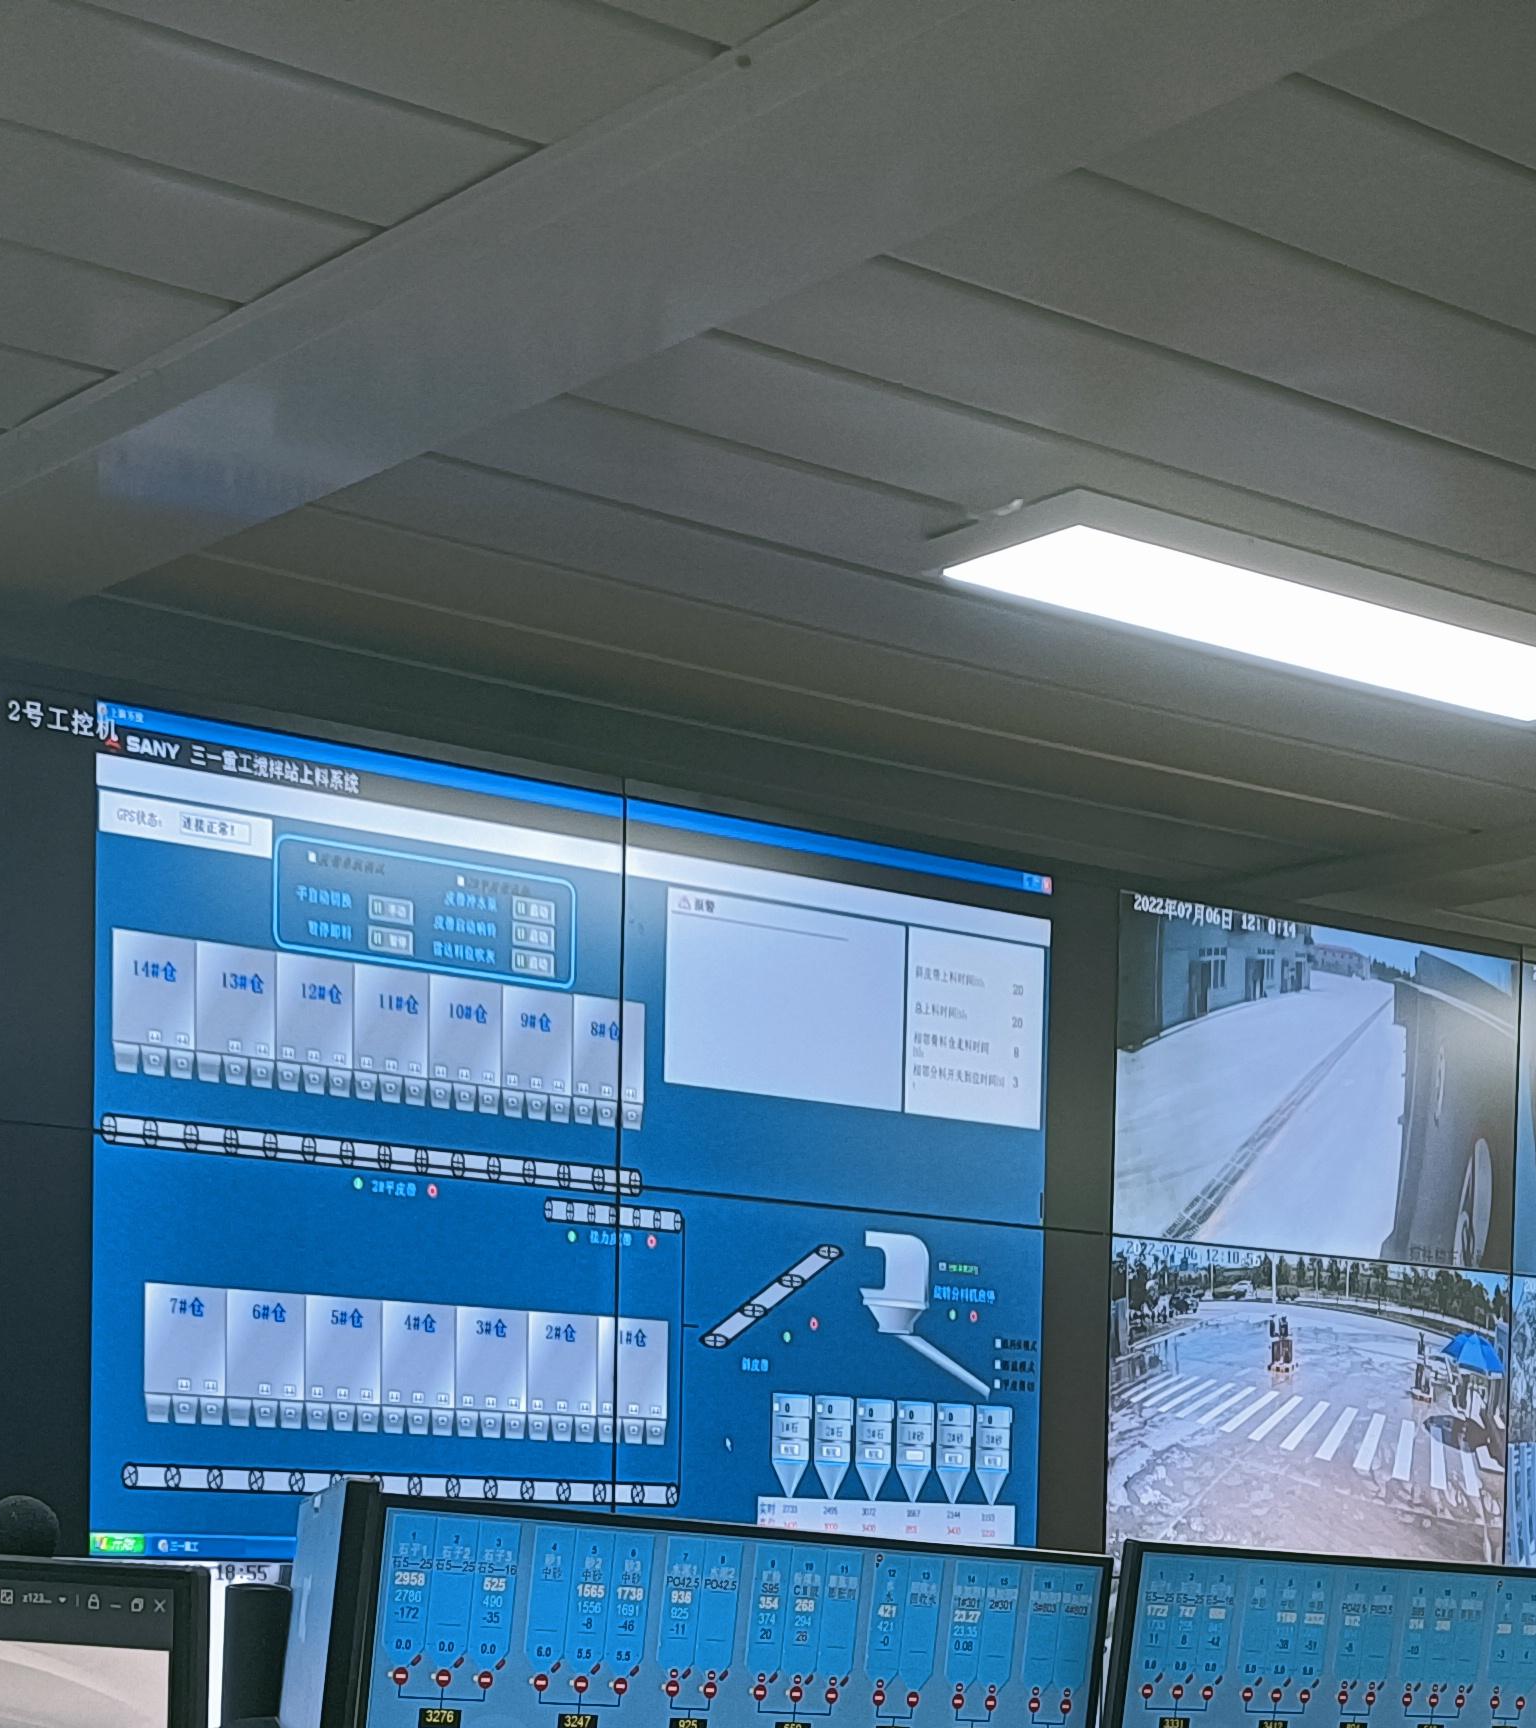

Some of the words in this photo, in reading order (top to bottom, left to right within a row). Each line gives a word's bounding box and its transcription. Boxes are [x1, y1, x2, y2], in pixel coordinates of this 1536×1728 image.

[8, 701, 118, 743] 2号工控机
[126, 736, 179, 761] SANY
[190, 746, 359, 794] 三一重工搅拌站上料系统
[1134, 894, 1233, 930] 2022年07月06日
[132, 958, 176, 983] 14#仓
[221, 971, 264, 994] 13#仓
[1013, 984, 1024, 996] 20
[300, 982, 342, 1005] 12#仓
[378, 993, 418, 1015] 11#仓
[449, 1002, 487, 1025] 10#仓
[520, 1012, 551, 1032] 9#仓
[1012, 1016, 1023, 1029] 20
[590, 1020, 620, 1041] 8#仓
[170, 1297, 204, 1318] 7#仓
[252, 1303, 286, 1323] 6#仓
[331, 1308, 364, 1329] 5#仓
[404, 1313, 436, 1334] 4#仓
[476, 1318, 507, 1338] 3#仓
[545, 1323, 576, 1343] 2#仓
[216, 1564, 269, 1581] 18:55
[395, 1572, 425, 1586] 2958
[483, 1579, 505, 1591] 525
[577, 1585, 604, 1598] 1565
[616, 1588, 643, 1600] 1738
[394, 1607, 419, 1619] -172
[482, 1612, 499, 1623] -35
[483, 1596, 503, 1608] 490
[577, 1602, 602, 1614] 1556
[616, 1604, 640, 1616] 1691
[395, 1638, 412, 1650] 0.0
[425, 1710, 454, 1723] 3276
[564, 1716, 591, 1728] 3247
